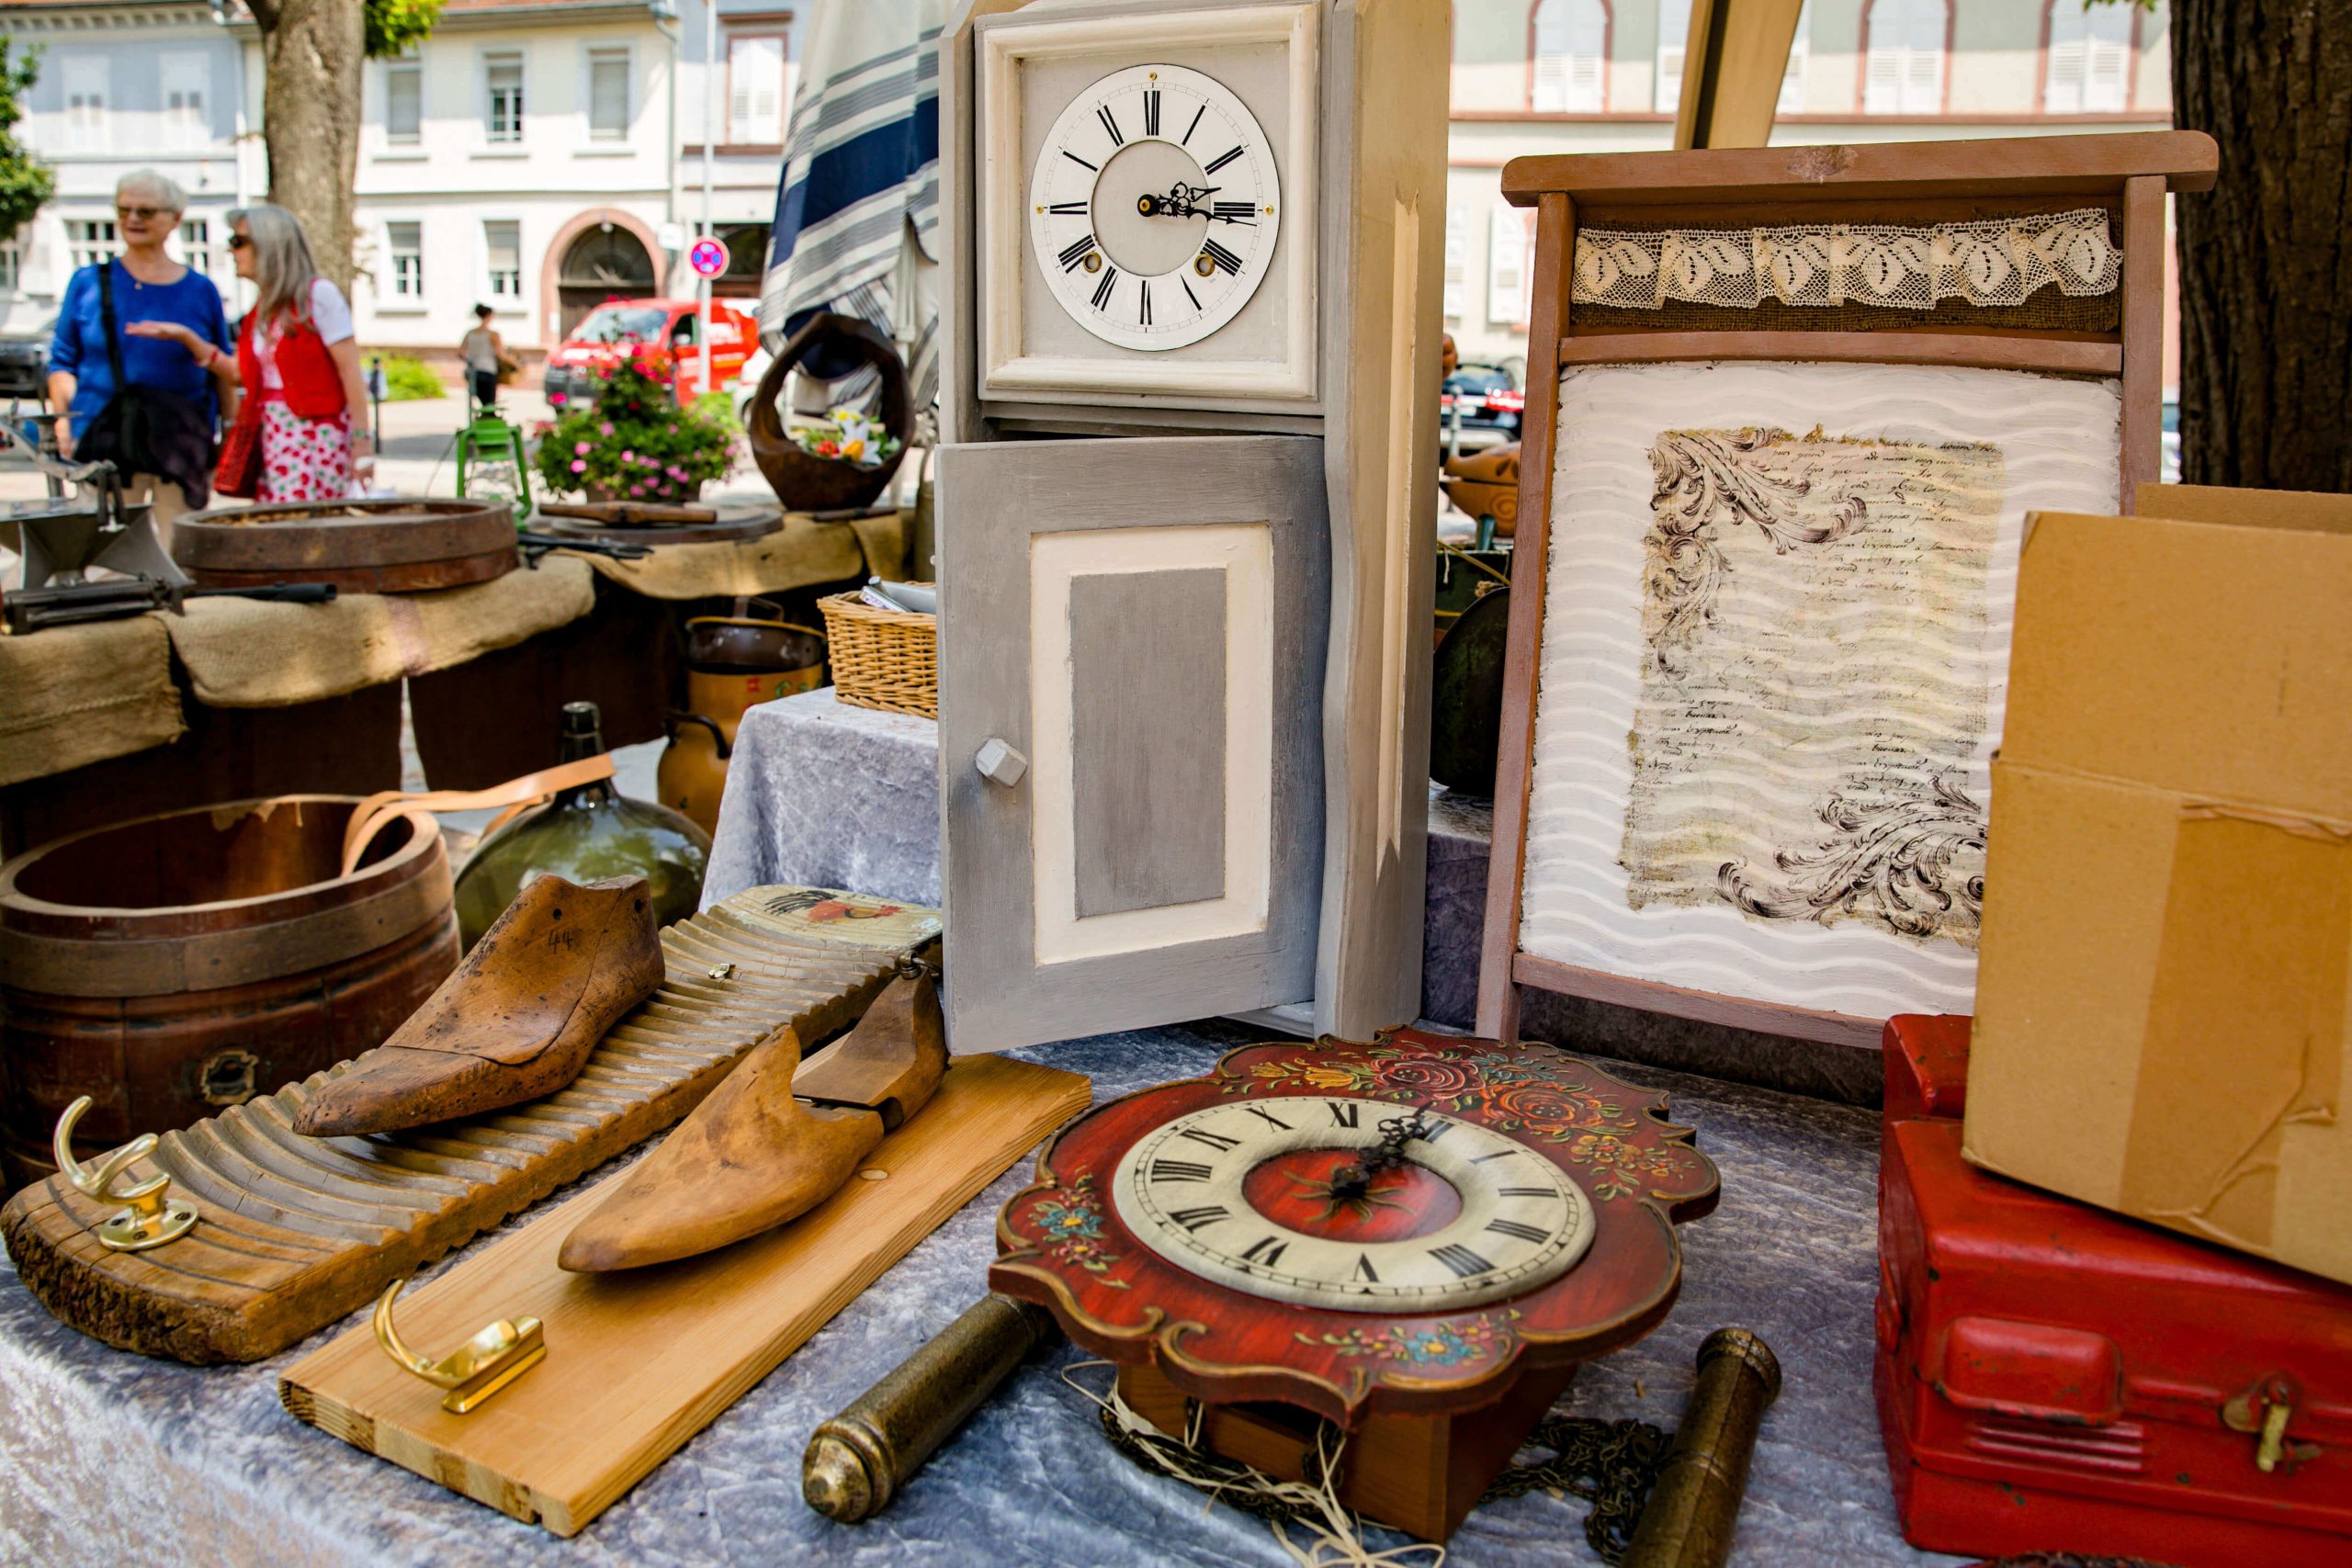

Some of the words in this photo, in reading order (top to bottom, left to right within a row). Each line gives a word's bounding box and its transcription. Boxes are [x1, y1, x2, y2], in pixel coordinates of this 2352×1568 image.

[1204, 144, 1244, 175] II
[1213, 201, 1256, 218] III
[548, 929, 574, 954] 44
[1245, 1106, 1295, 1133] X
[1327, 1102, 1359, 1128] XI
[1498, 1188, 1559, 1199] II
[1484, 1218, 1552, 1245] III
[1352, 1252, 1381, 1282] V
